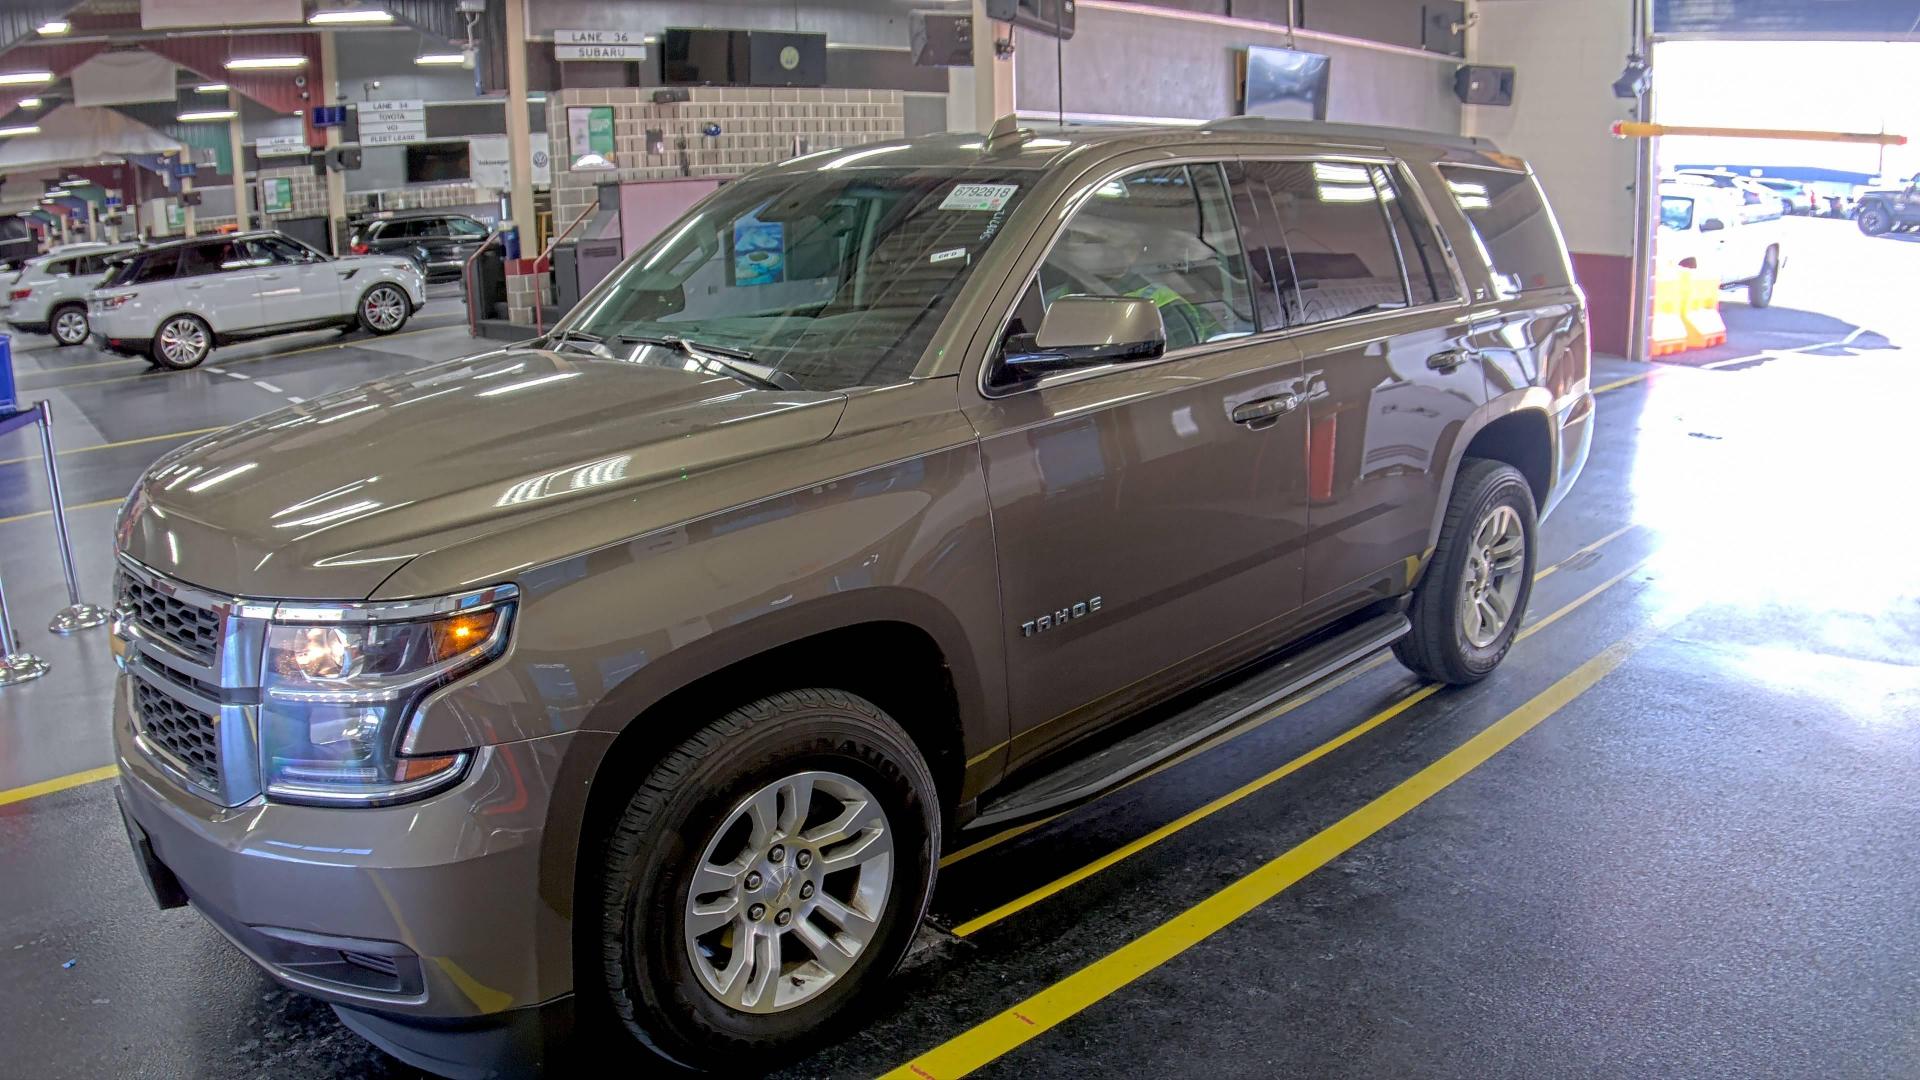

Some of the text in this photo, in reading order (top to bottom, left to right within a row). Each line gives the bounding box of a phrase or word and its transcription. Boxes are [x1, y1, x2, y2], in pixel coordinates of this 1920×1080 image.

[571, 32, 628, 42] LANE 36
[578, 47, 625, 57] SUBARU
[954, 186, 1011, 198] 6792818
[1021, 596, 1102, 638] TAHOE
